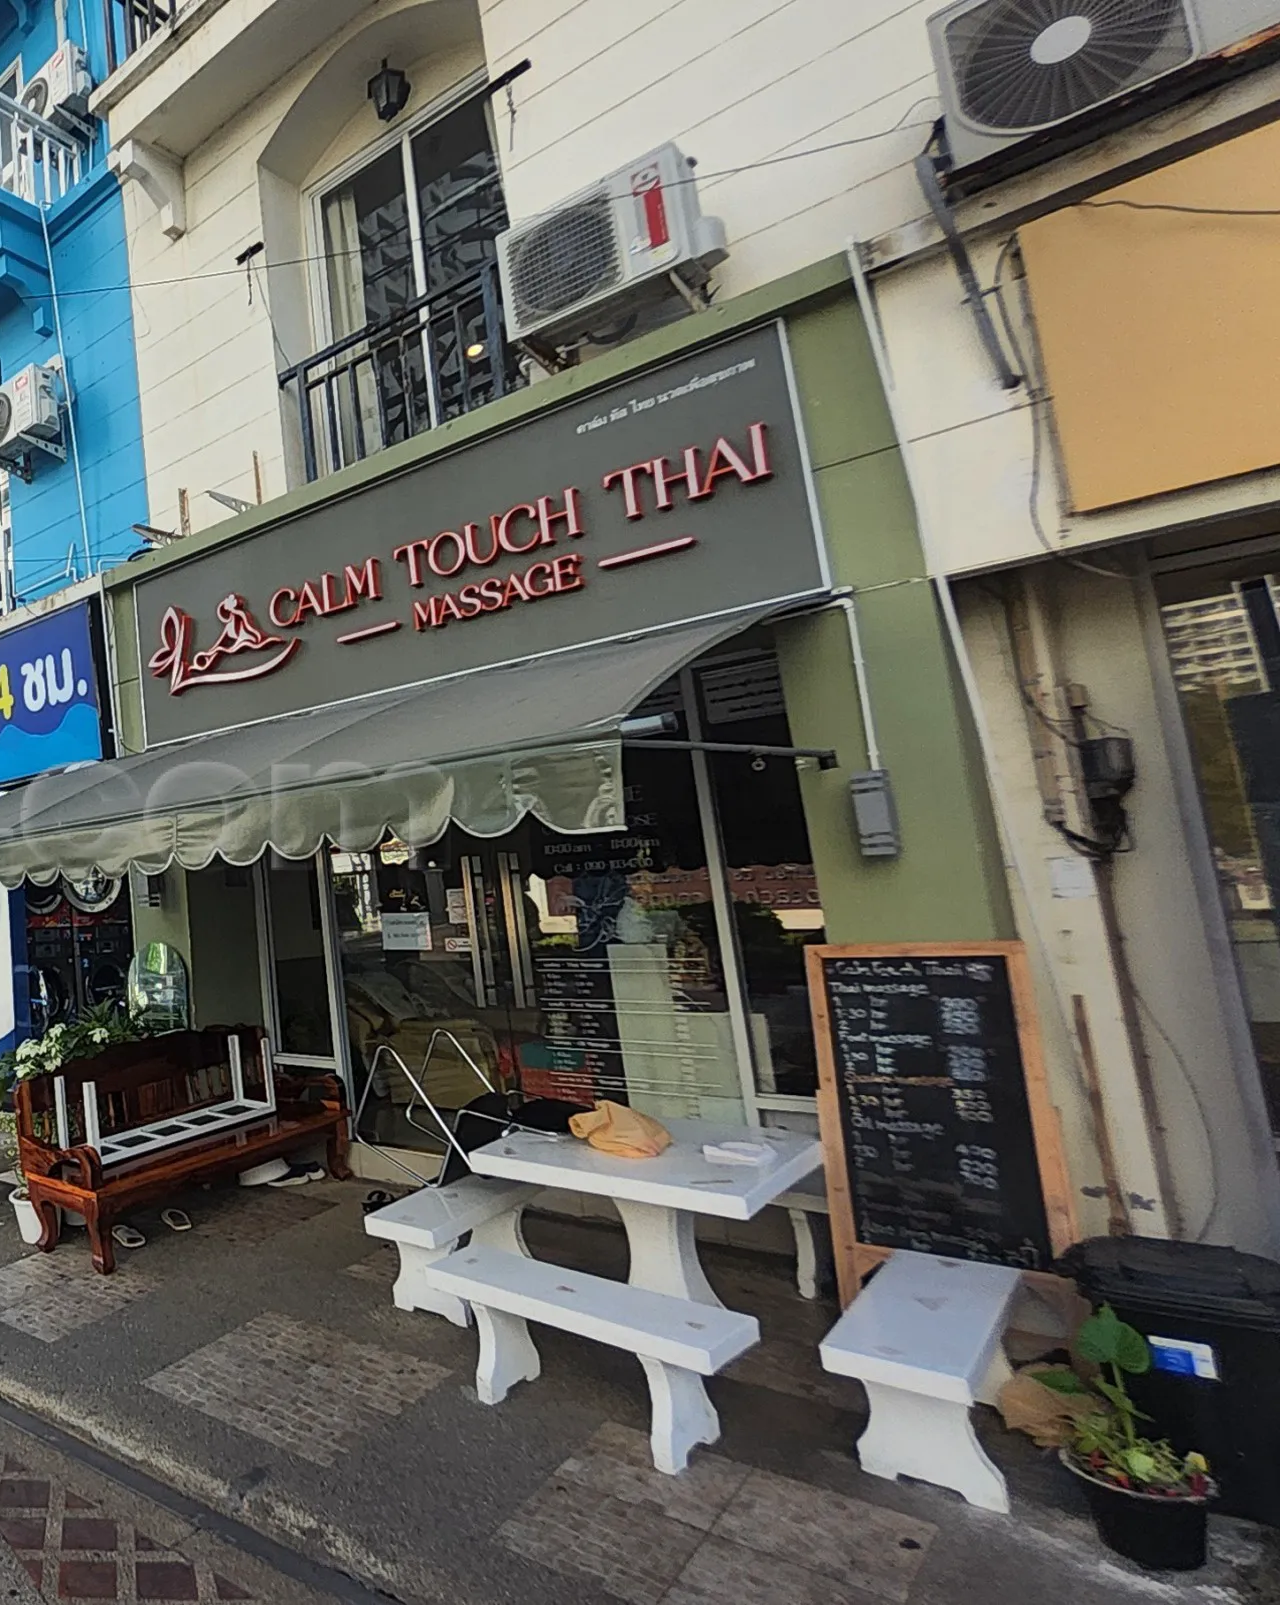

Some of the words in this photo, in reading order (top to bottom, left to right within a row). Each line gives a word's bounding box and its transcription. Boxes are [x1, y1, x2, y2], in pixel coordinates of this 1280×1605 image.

[268, 555, 385, 629] CALM
[392, 485, 585, 590] TOUCH
[603, 421, 775, 521] THAI
[412, 552, 587, 633] MASSAGE
[20, 647, 89, 713] ชม.
